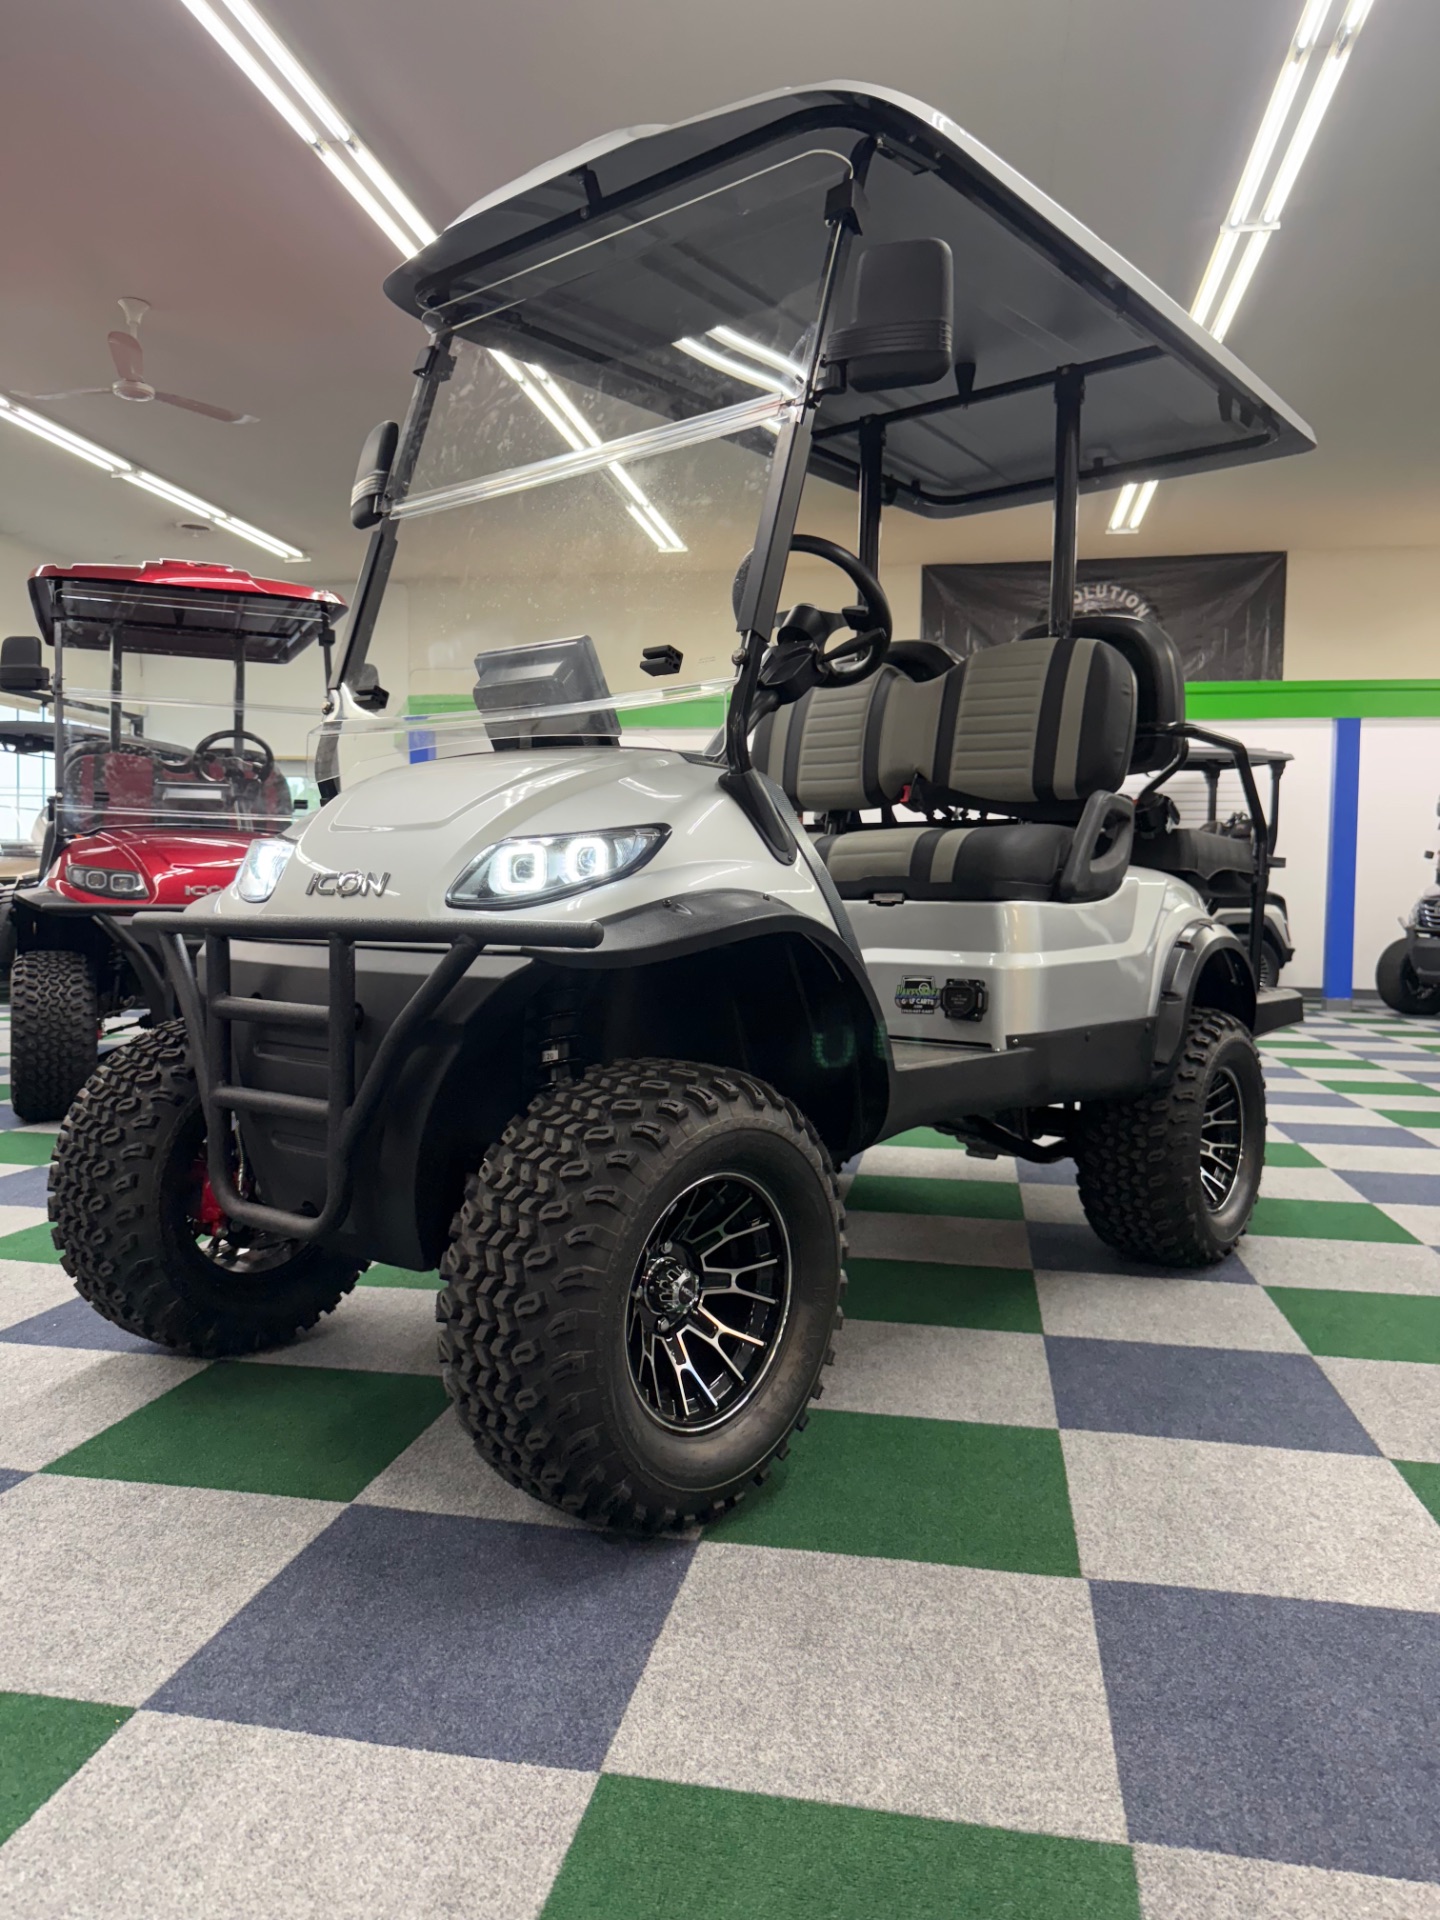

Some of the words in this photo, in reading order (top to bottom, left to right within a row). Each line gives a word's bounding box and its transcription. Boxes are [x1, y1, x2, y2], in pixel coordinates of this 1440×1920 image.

[1073, 584, 1150, 618] OLUTION
[184, 884, 223, 897] ICO
[305, 870, 391, 898] ICON
